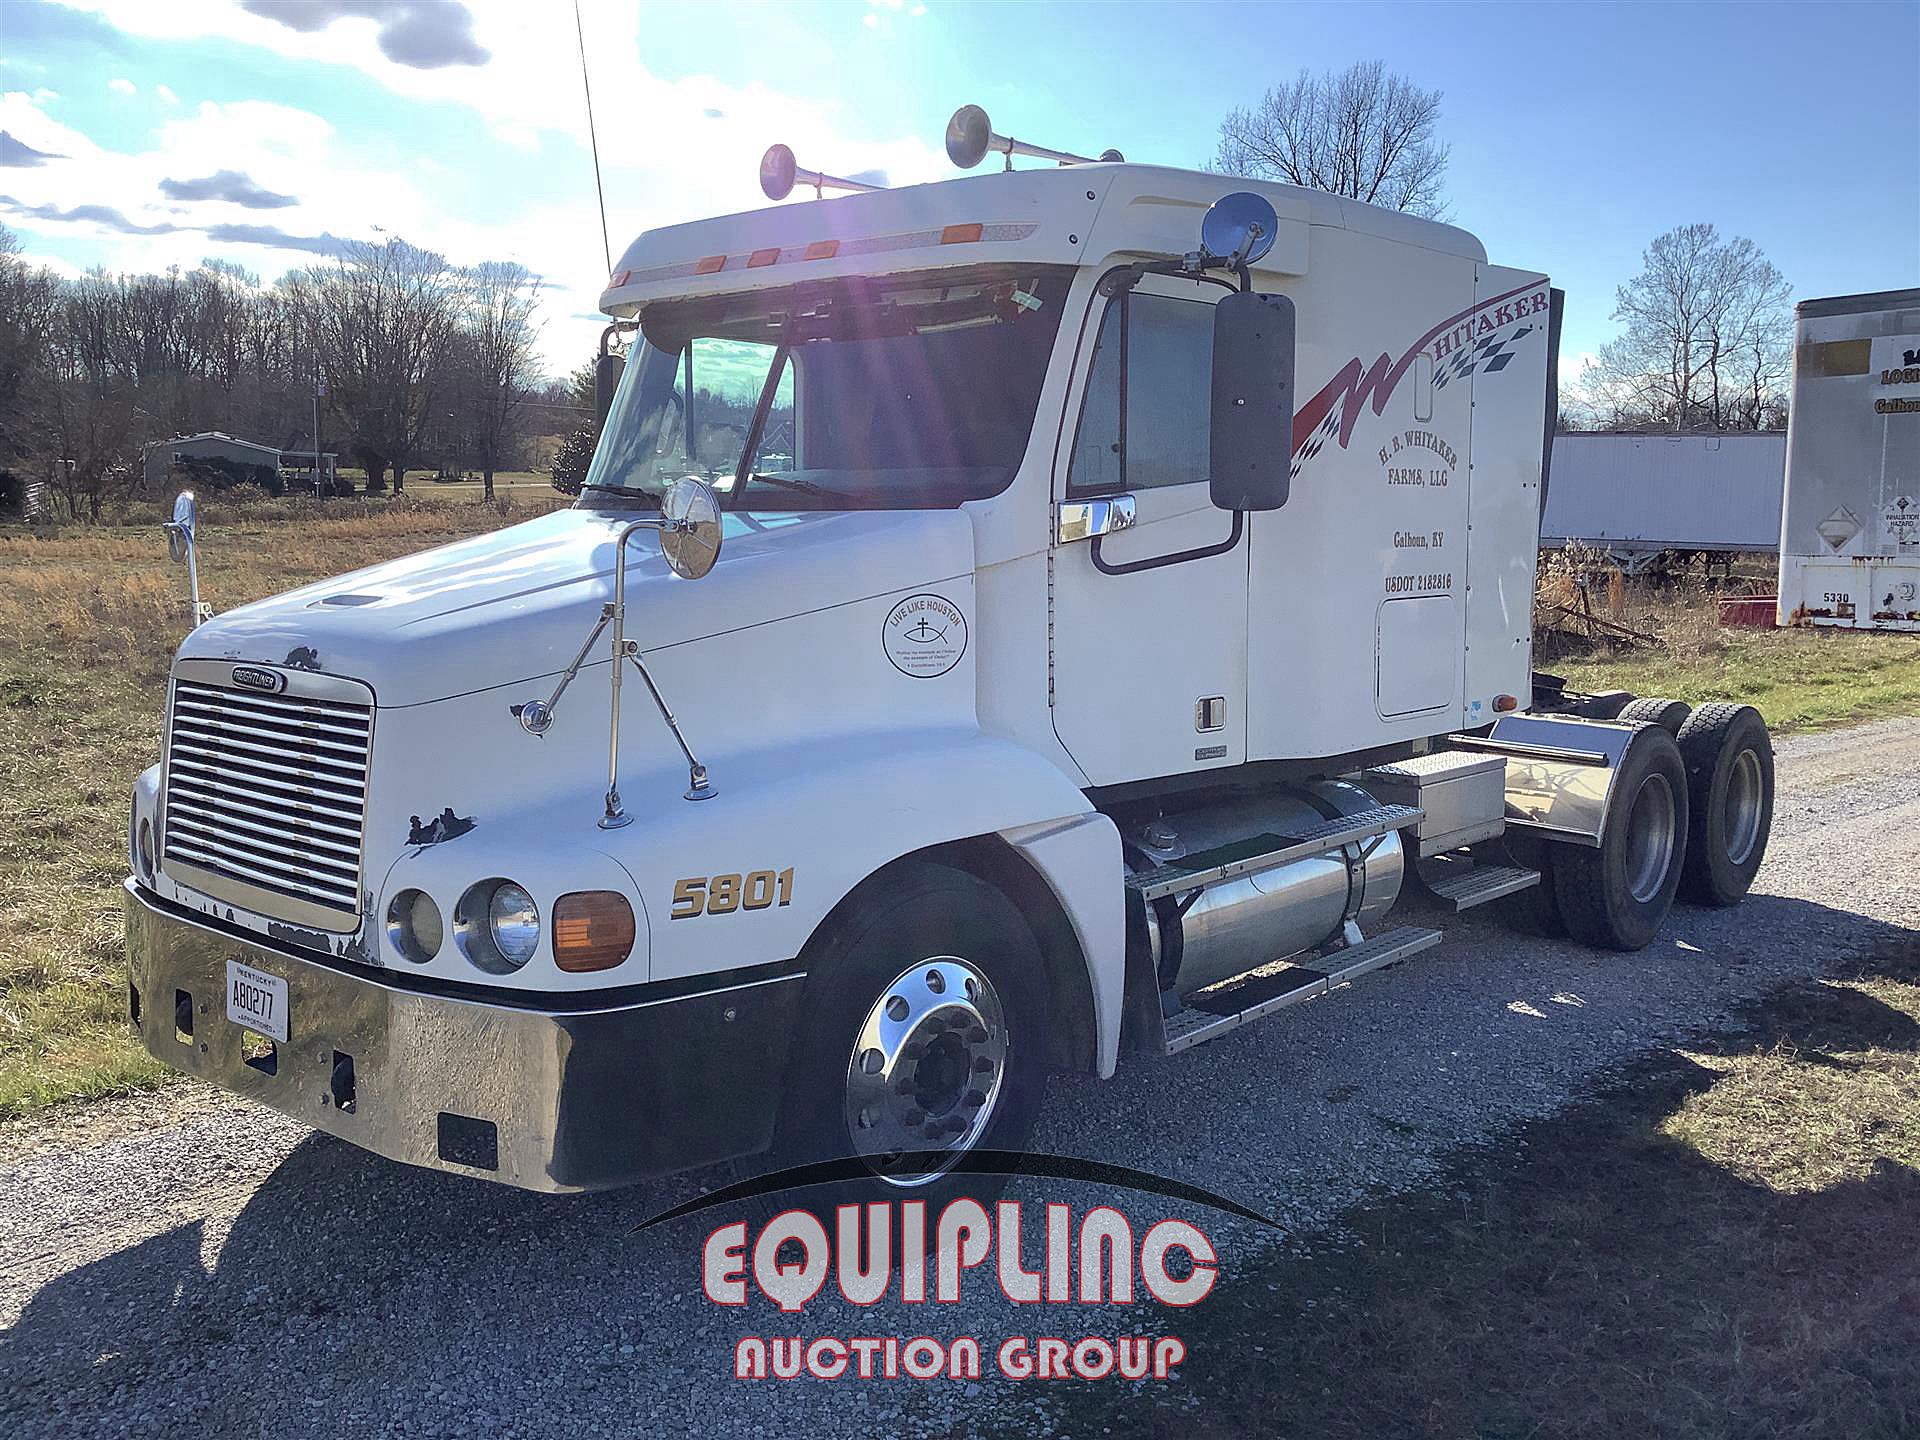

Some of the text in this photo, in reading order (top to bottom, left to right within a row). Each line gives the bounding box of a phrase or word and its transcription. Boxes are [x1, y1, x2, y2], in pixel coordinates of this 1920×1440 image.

[1405, 430, 1457, 471] WHITAKER
[1388, 468, 1426, 488] FARMS,
[1886, 513, 1919, 521] INHALATION
[1393, 531, 1444, 550] Calhoun, KY
[1385, 576, 1415, 592] USDOT
[1823, 592, 1849, 603] 5330
[890, 600, 961, 628] LIVE LIKE HOUSTON
[233, 669, 274, 688] FREIGHTLINER
[671, 867, 794, 920] 5801
[240, 970, 272, 987] KENTUCKY
